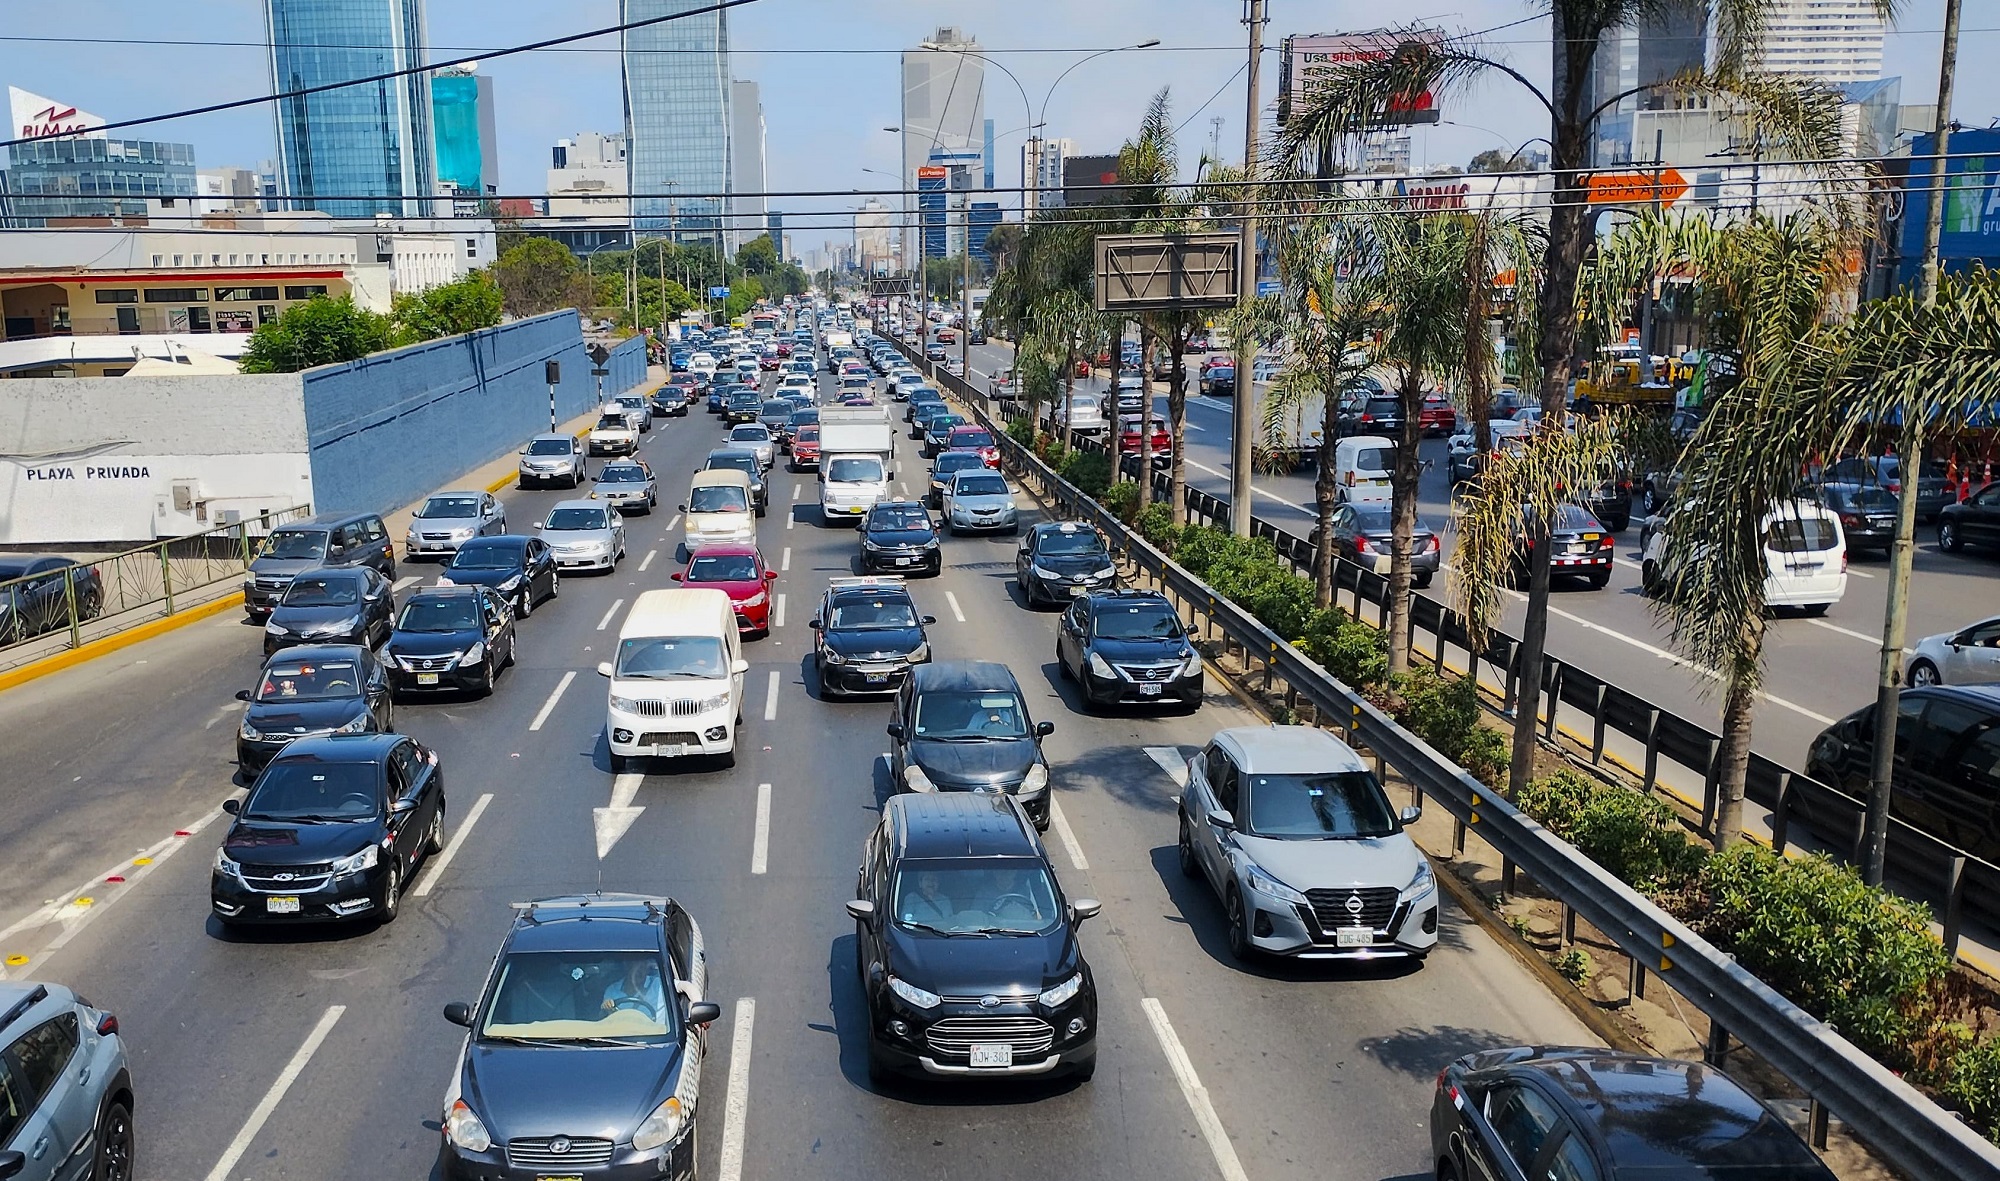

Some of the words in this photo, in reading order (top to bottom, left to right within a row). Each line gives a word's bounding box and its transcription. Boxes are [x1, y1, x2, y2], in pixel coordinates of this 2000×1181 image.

[27, 467, 75, 480] PLAYA
[86, 466, 150, 479] PRIVADA
[268, 900, 299, 909] BPX-575
[972, 1051, 1010, 1063] AJW-381
